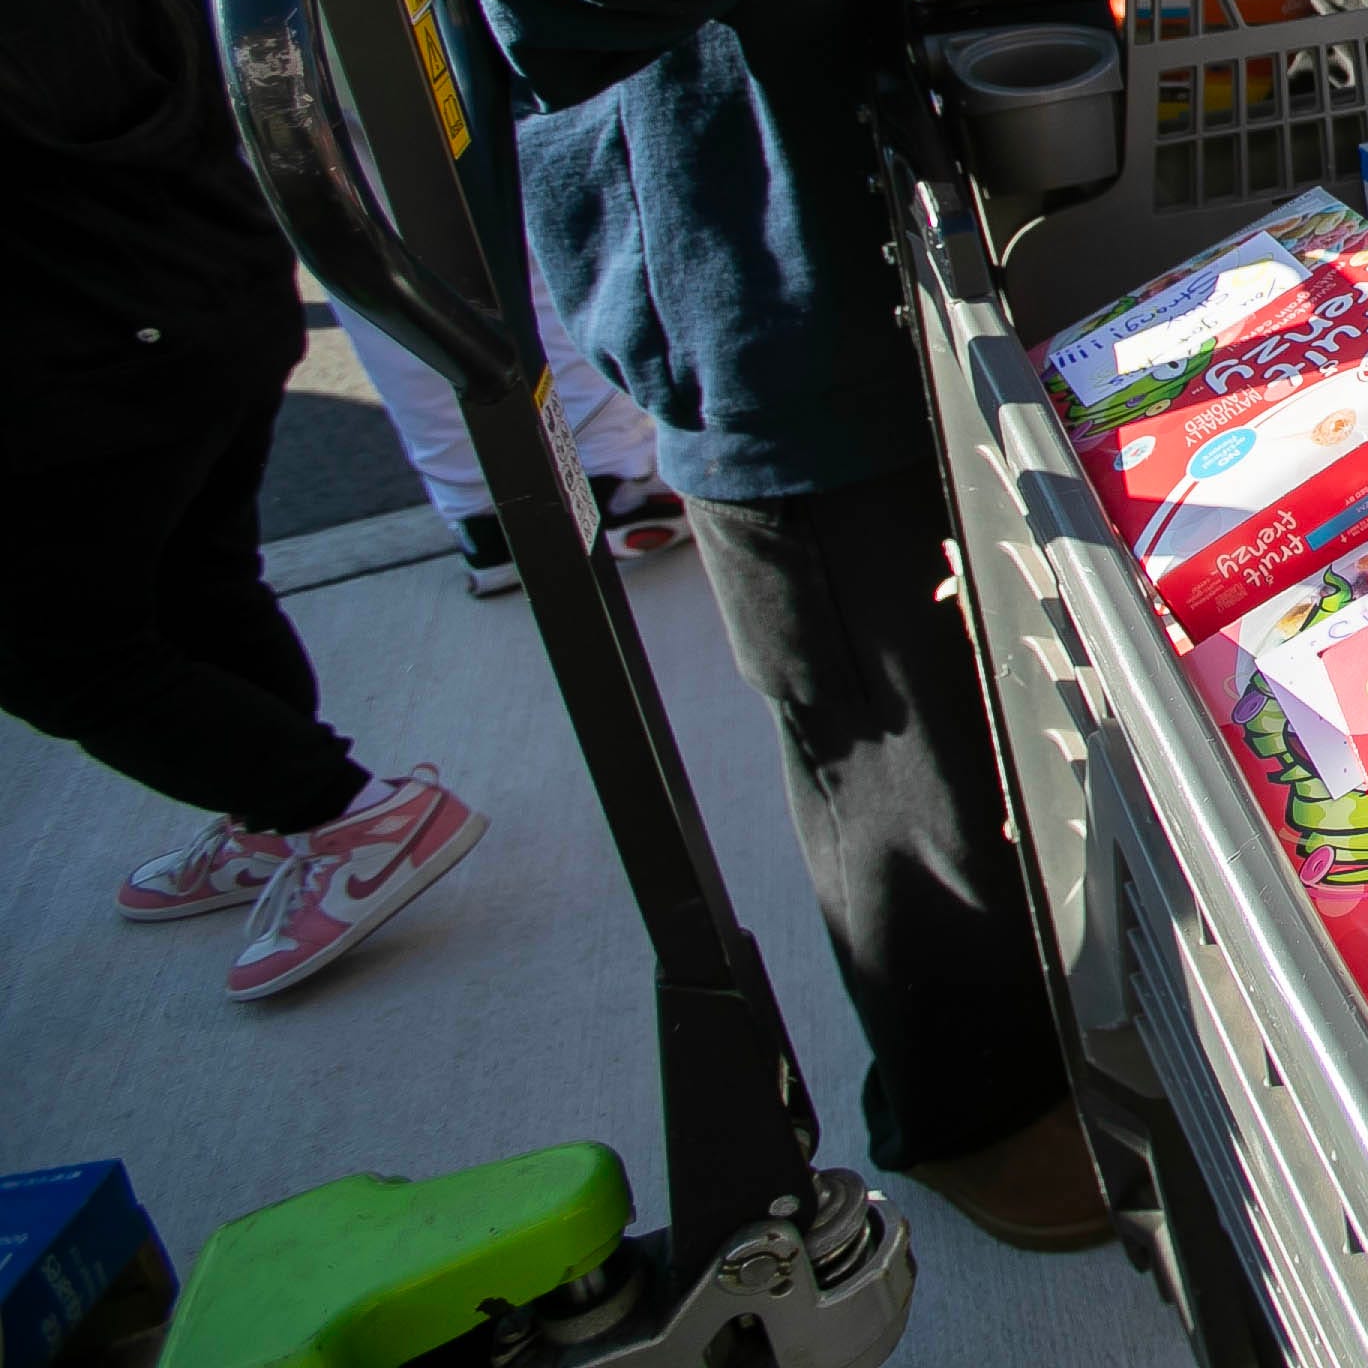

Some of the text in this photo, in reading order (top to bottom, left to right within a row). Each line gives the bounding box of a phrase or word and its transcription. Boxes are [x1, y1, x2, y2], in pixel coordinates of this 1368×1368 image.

[1185, 384, 1263, 448] NATURALLY
[1216, 508, 1298, 579] frenzy
[1244, 532, 1305, 588] fruit
